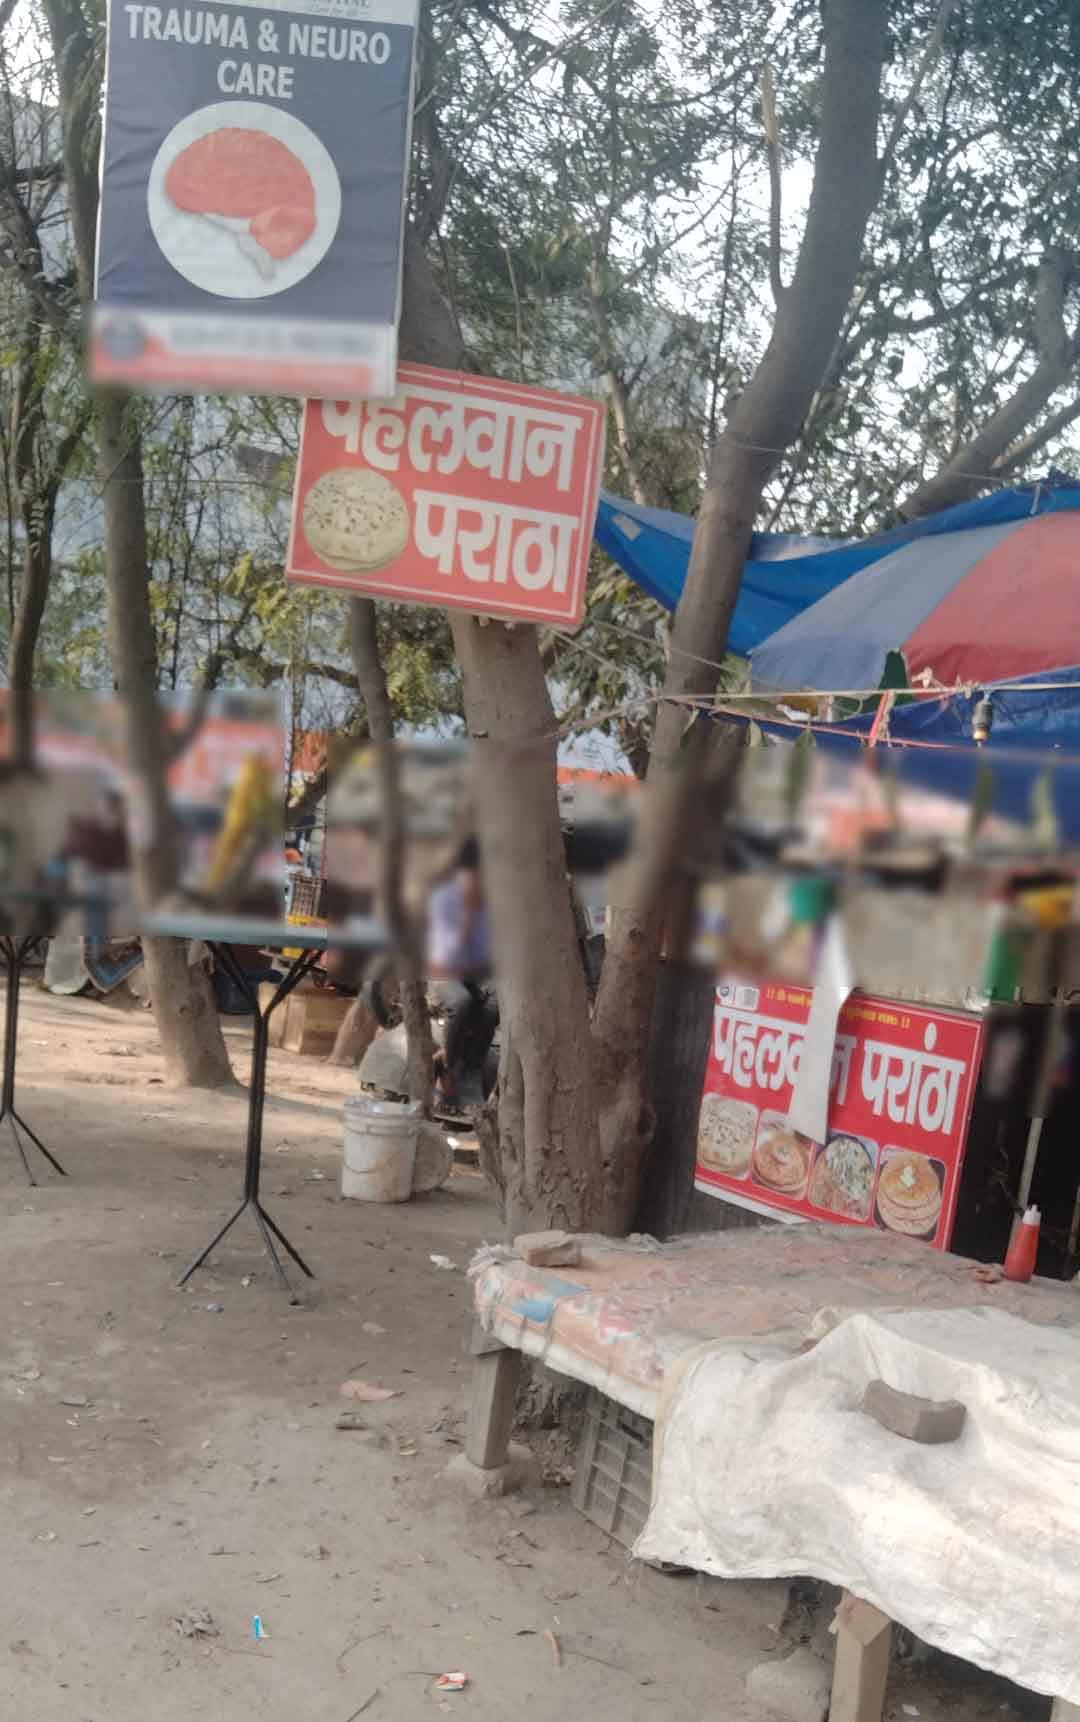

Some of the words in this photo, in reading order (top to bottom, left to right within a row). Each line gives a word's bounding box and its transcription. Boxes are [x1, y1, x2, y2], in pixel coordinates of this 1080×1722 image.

[125, 5, 248, 50] TRAUMA
[257, 19, 279, 53] &
[288, 23, 390, 65] NEURO
[217, 60, 294, 99] CARE
[321, 382, 583, 491] पहलवान
[413, 488, 579, 593] पराठा
